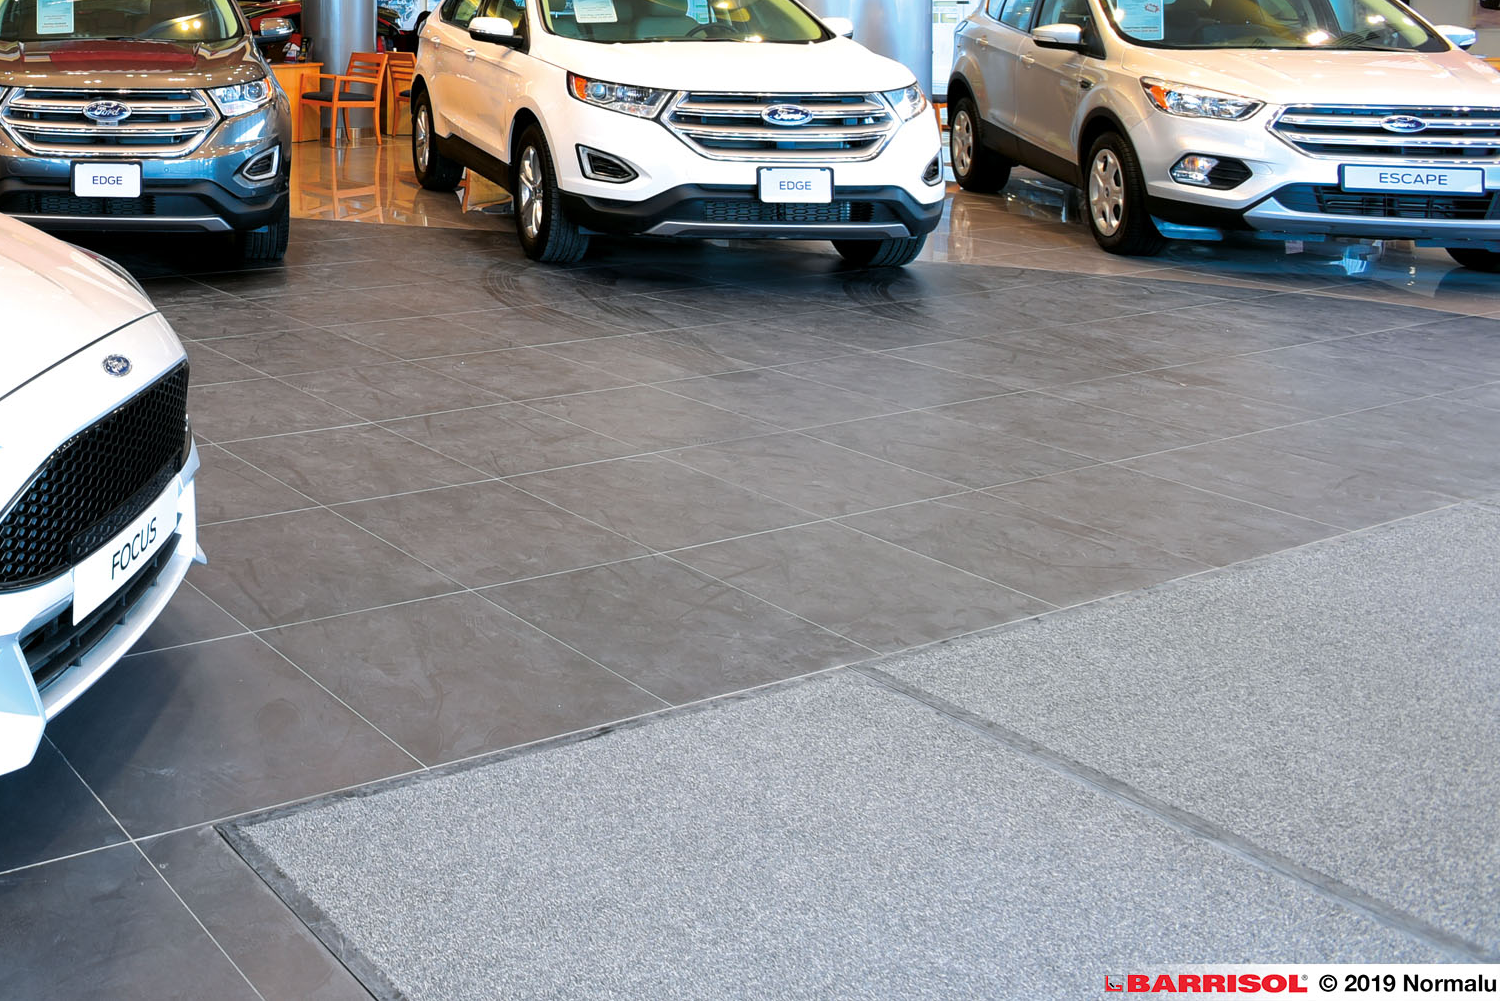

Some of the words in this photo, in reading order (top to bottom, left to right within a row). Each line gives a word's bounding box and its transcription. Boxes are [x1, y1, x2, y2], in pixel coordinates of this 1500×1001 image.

[92, 176, 123, 185] EDGE
[1379, 172, 1448, 185] ESCAPE
[779, 180, 812, 191] EDGE
[111, 517, 157, 580] FOCUS
